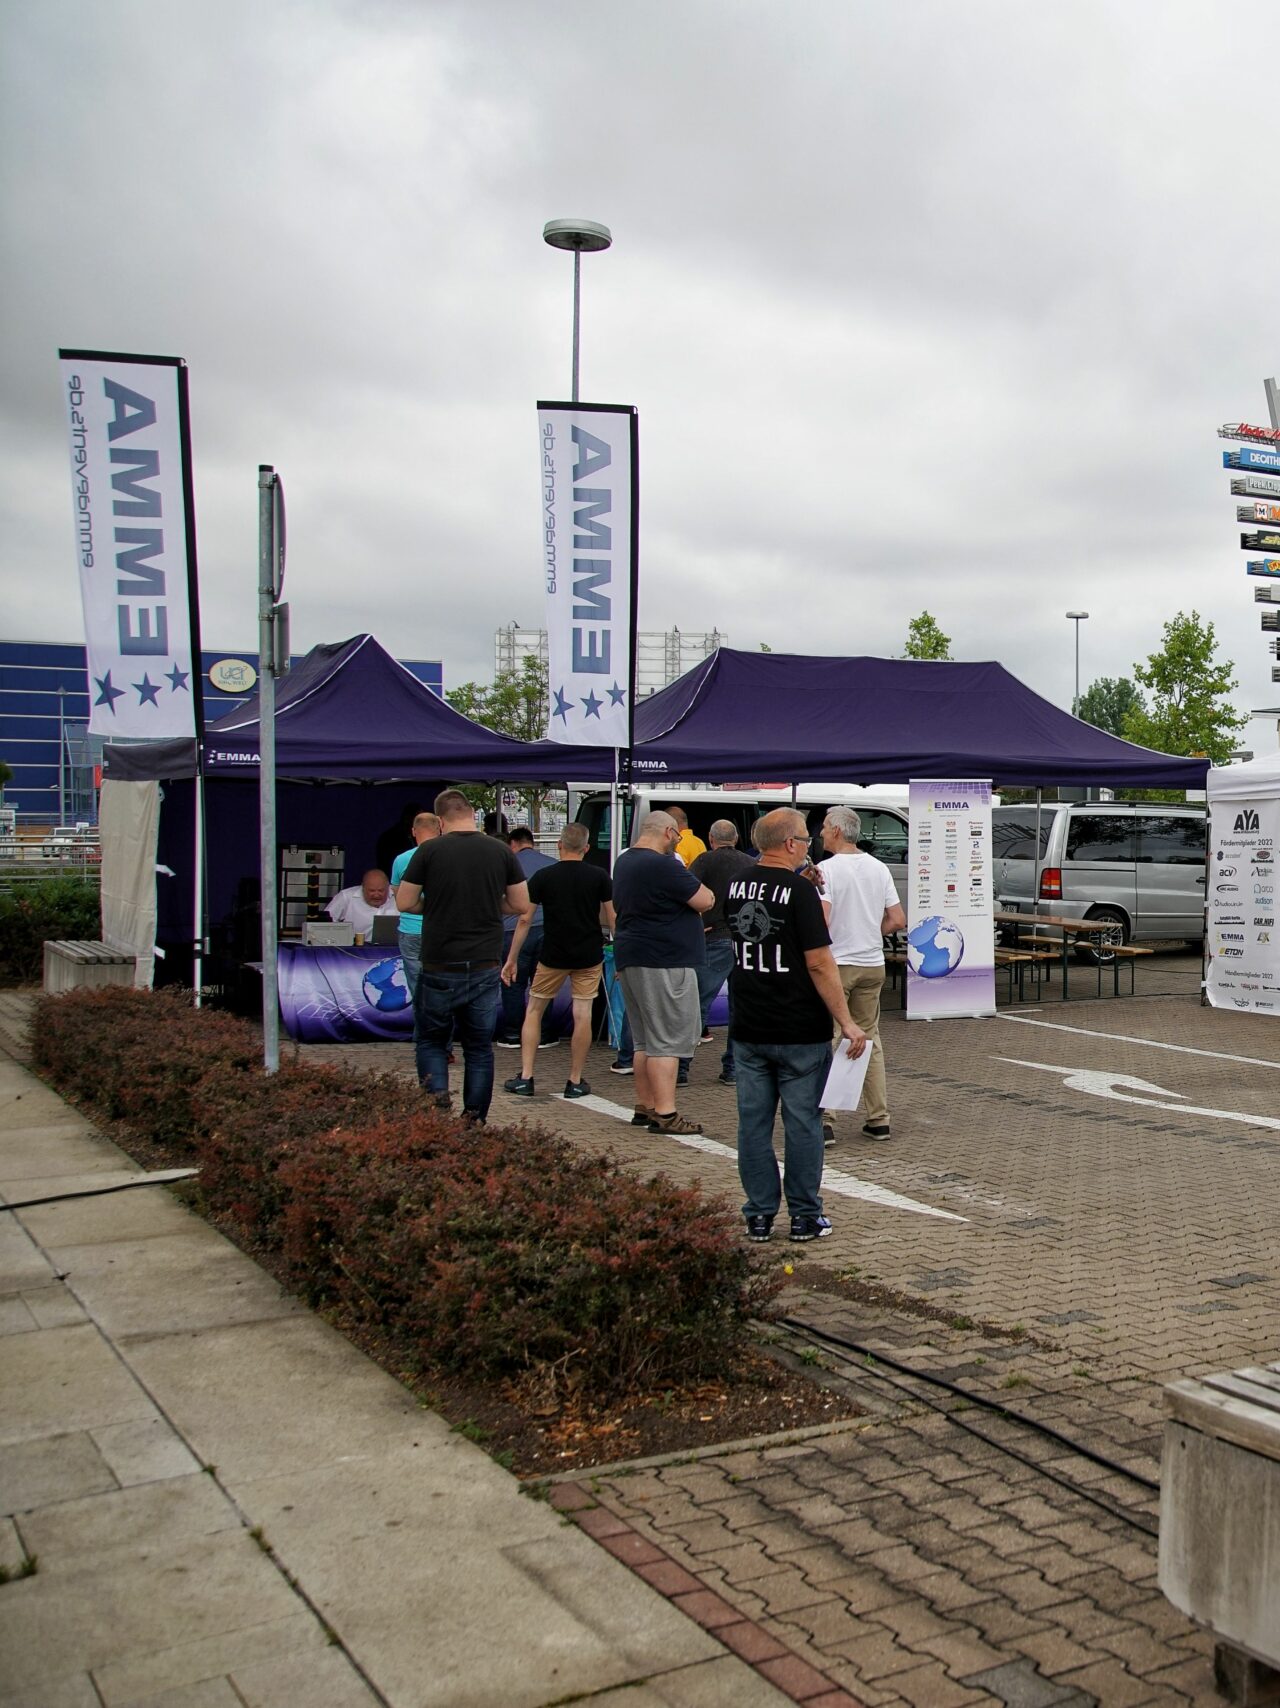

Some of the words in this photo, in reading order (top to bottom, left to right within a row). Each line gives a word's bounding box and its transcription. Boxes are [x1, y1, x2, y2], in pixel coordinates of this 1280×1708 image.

[216, 752, 261, 761] EMMA
[631, 760, 668, 769] EMMA
[934, 801, 970, 809] EMMA
[1233, 809, 1260, 831] AYA
[1220, 840, 1257, 848] Fördermitglieder
[1219, 868, 1234, 877] acv
[728, 881, 768, 901] MADE
[772, 884, 792, 905] IN
[1221, 933, 1245, 941] EMMA
